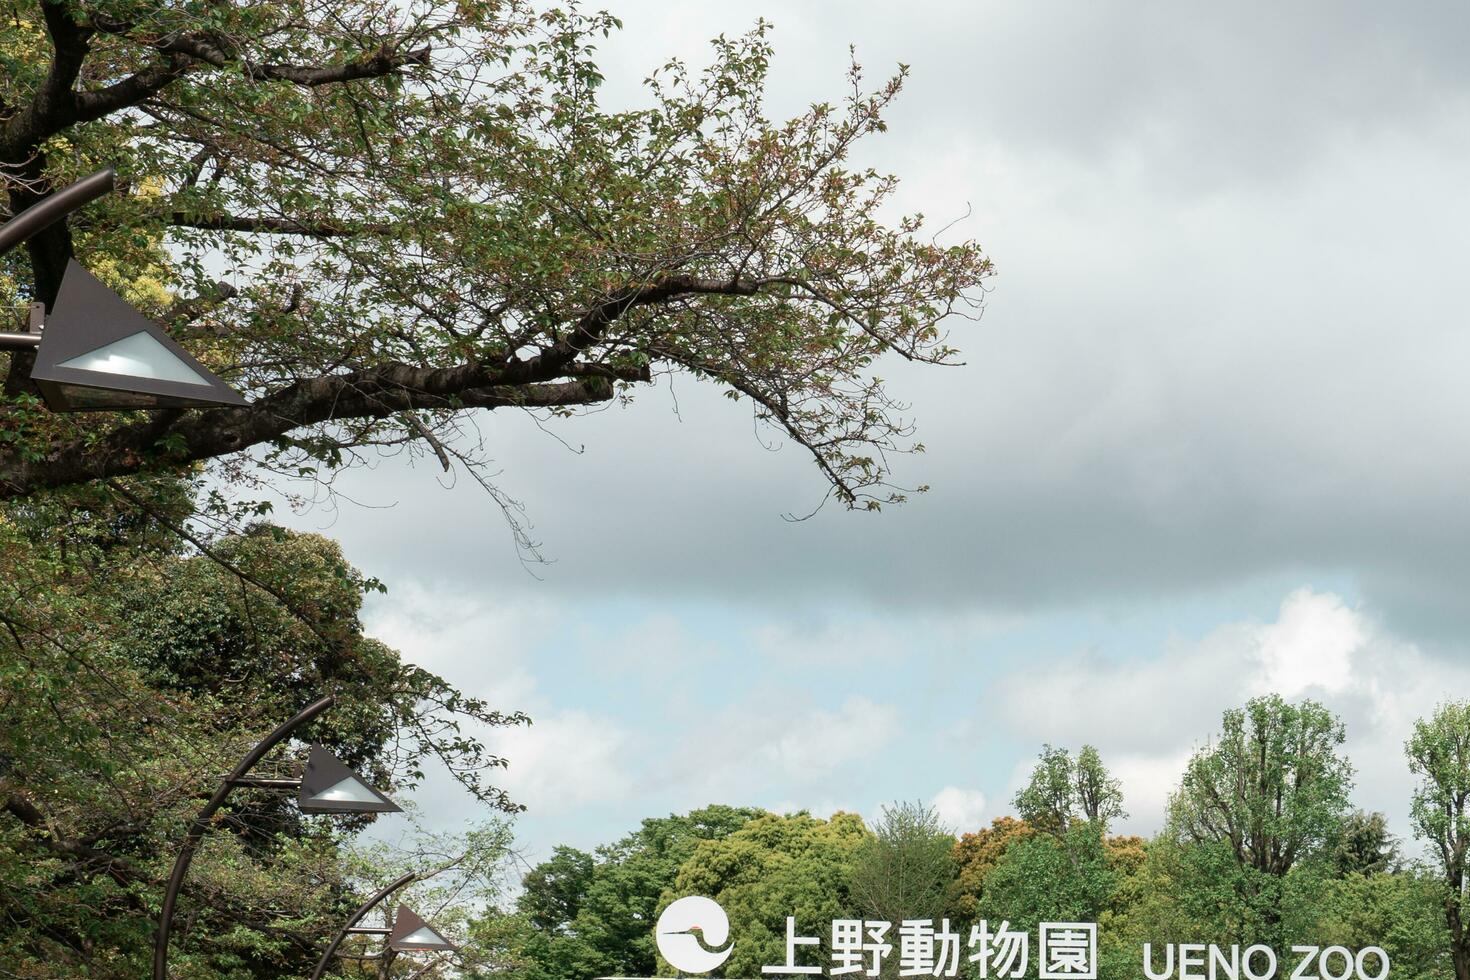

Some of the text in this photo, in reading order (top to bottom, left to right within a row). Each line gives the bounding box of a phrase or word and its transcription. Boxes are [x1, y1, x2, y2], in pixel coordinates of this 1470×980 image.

[761, 916, 1097, 980] 上野動物園
